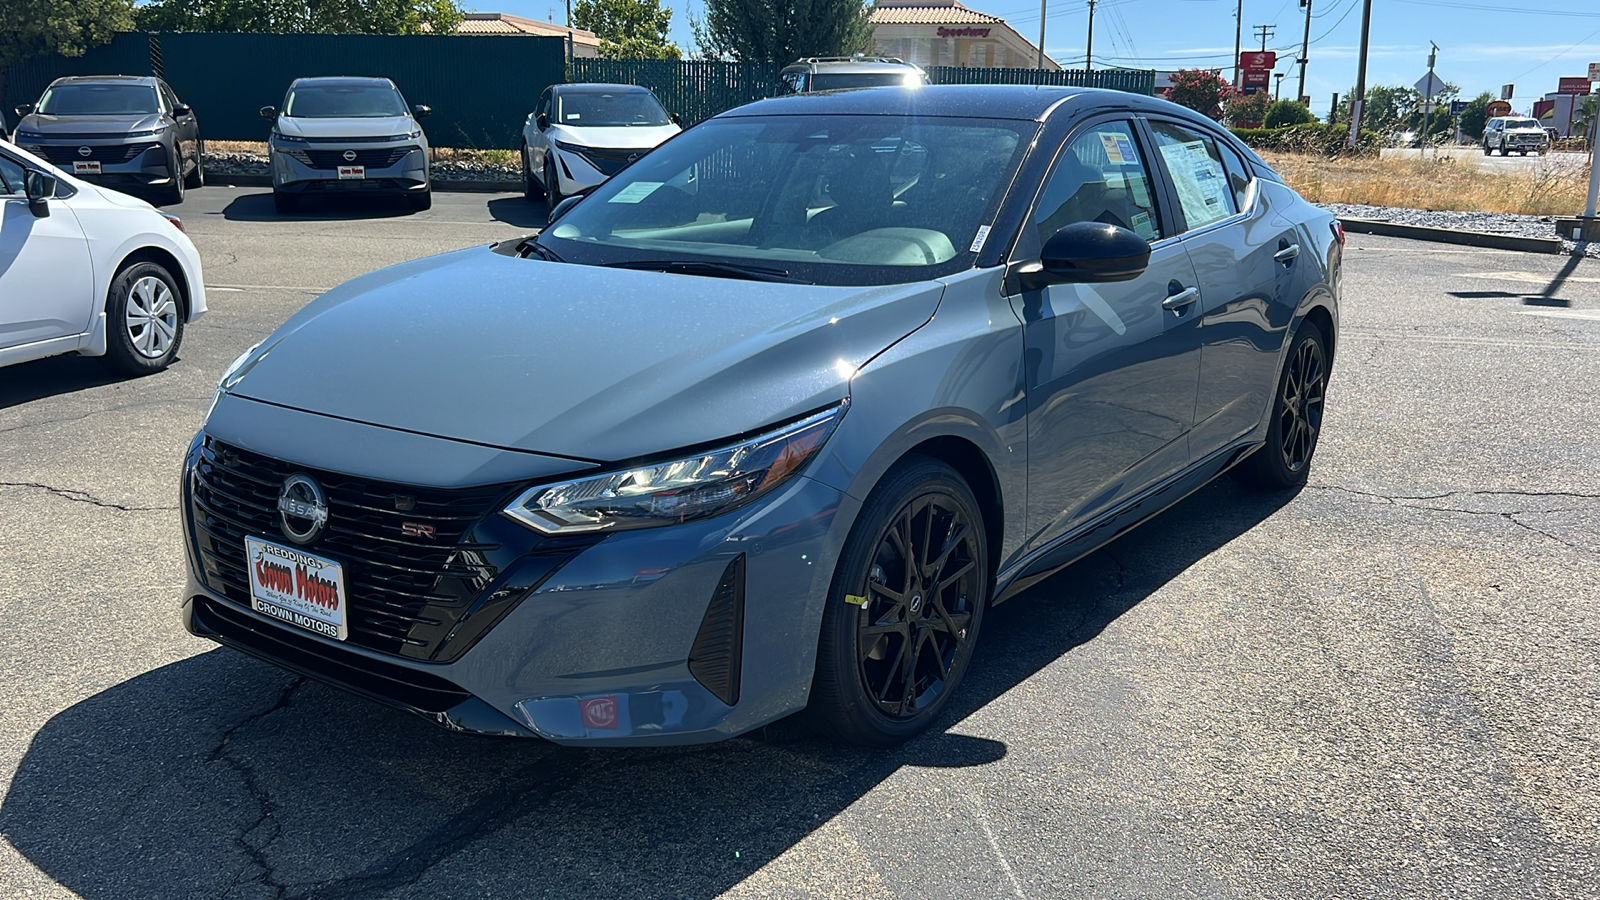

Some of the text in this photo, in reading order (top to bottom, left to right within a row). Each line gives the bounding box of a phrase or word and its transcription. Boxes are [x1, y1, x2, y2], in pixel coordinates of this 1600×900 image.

[937, 26, 991, 38] Speedway
[402, 522, 435, 539] SR
[256, 560, 339, 611] Crown Motors
[257, 601, 337, 636] CROWN MOTORS
